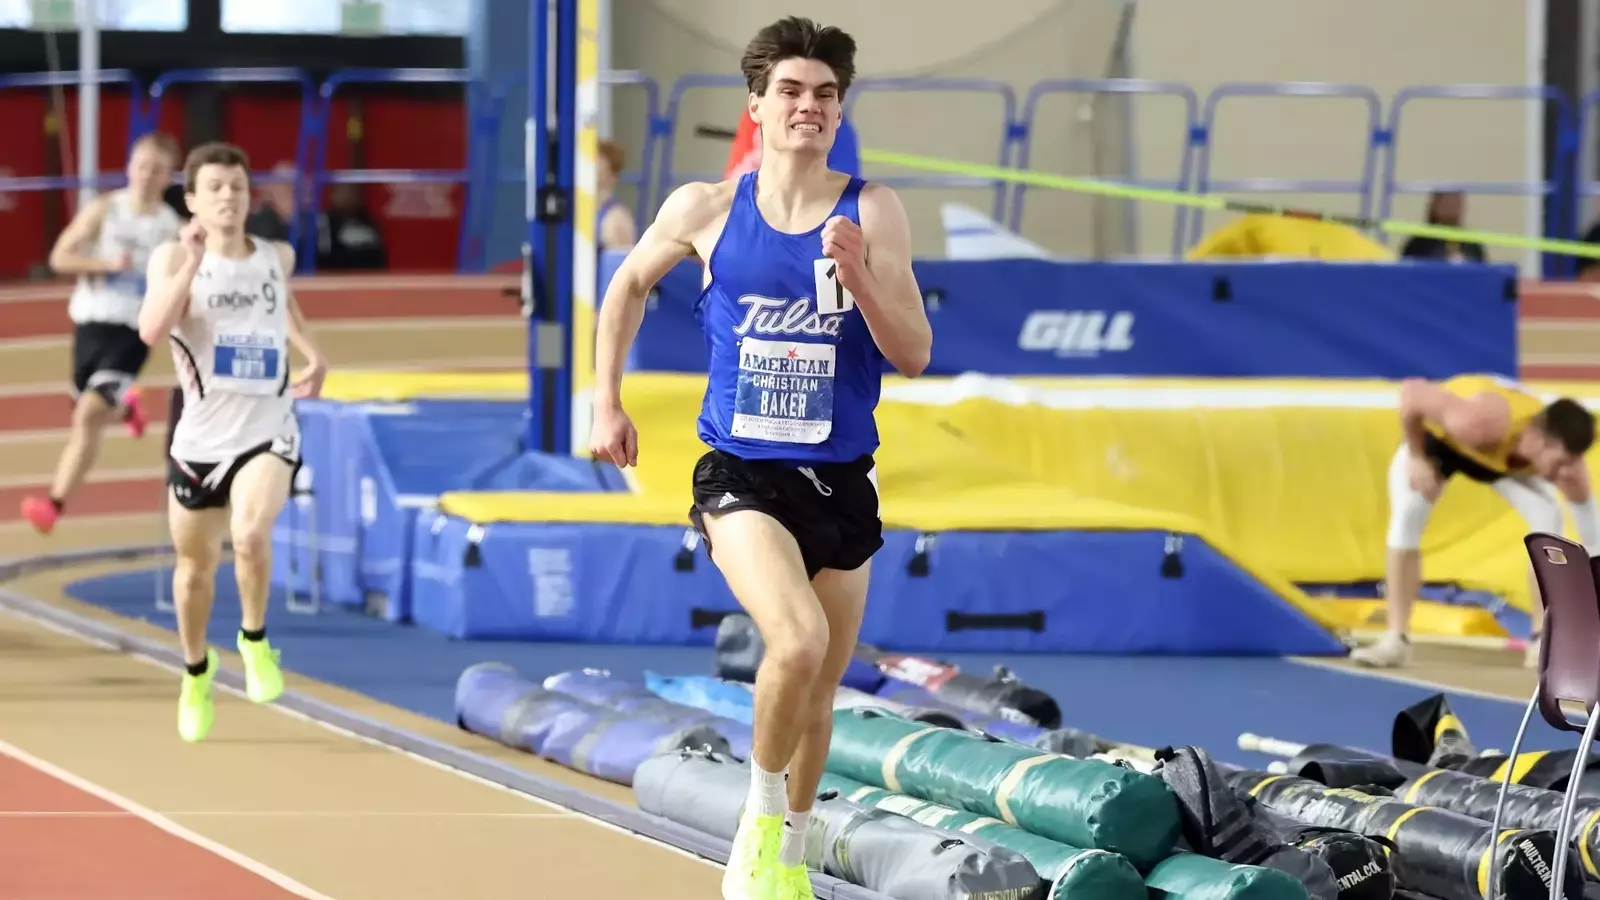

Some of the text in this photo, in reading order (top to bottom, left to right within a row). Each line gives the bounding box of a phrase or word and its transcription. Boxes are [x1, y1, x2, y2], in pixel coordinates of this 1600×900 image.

[262, 282, 276, 315] 9
[825, 262, 844, 310] 1
[732, 294, 844, 336] Tulsa
[1018, 309, 1135, 351] GILL
[743, 353, 830, 375] AMERICAN
[752, 374, 818, 391] CHRISTIAN
[760, 390, 807, 418] BAKER
